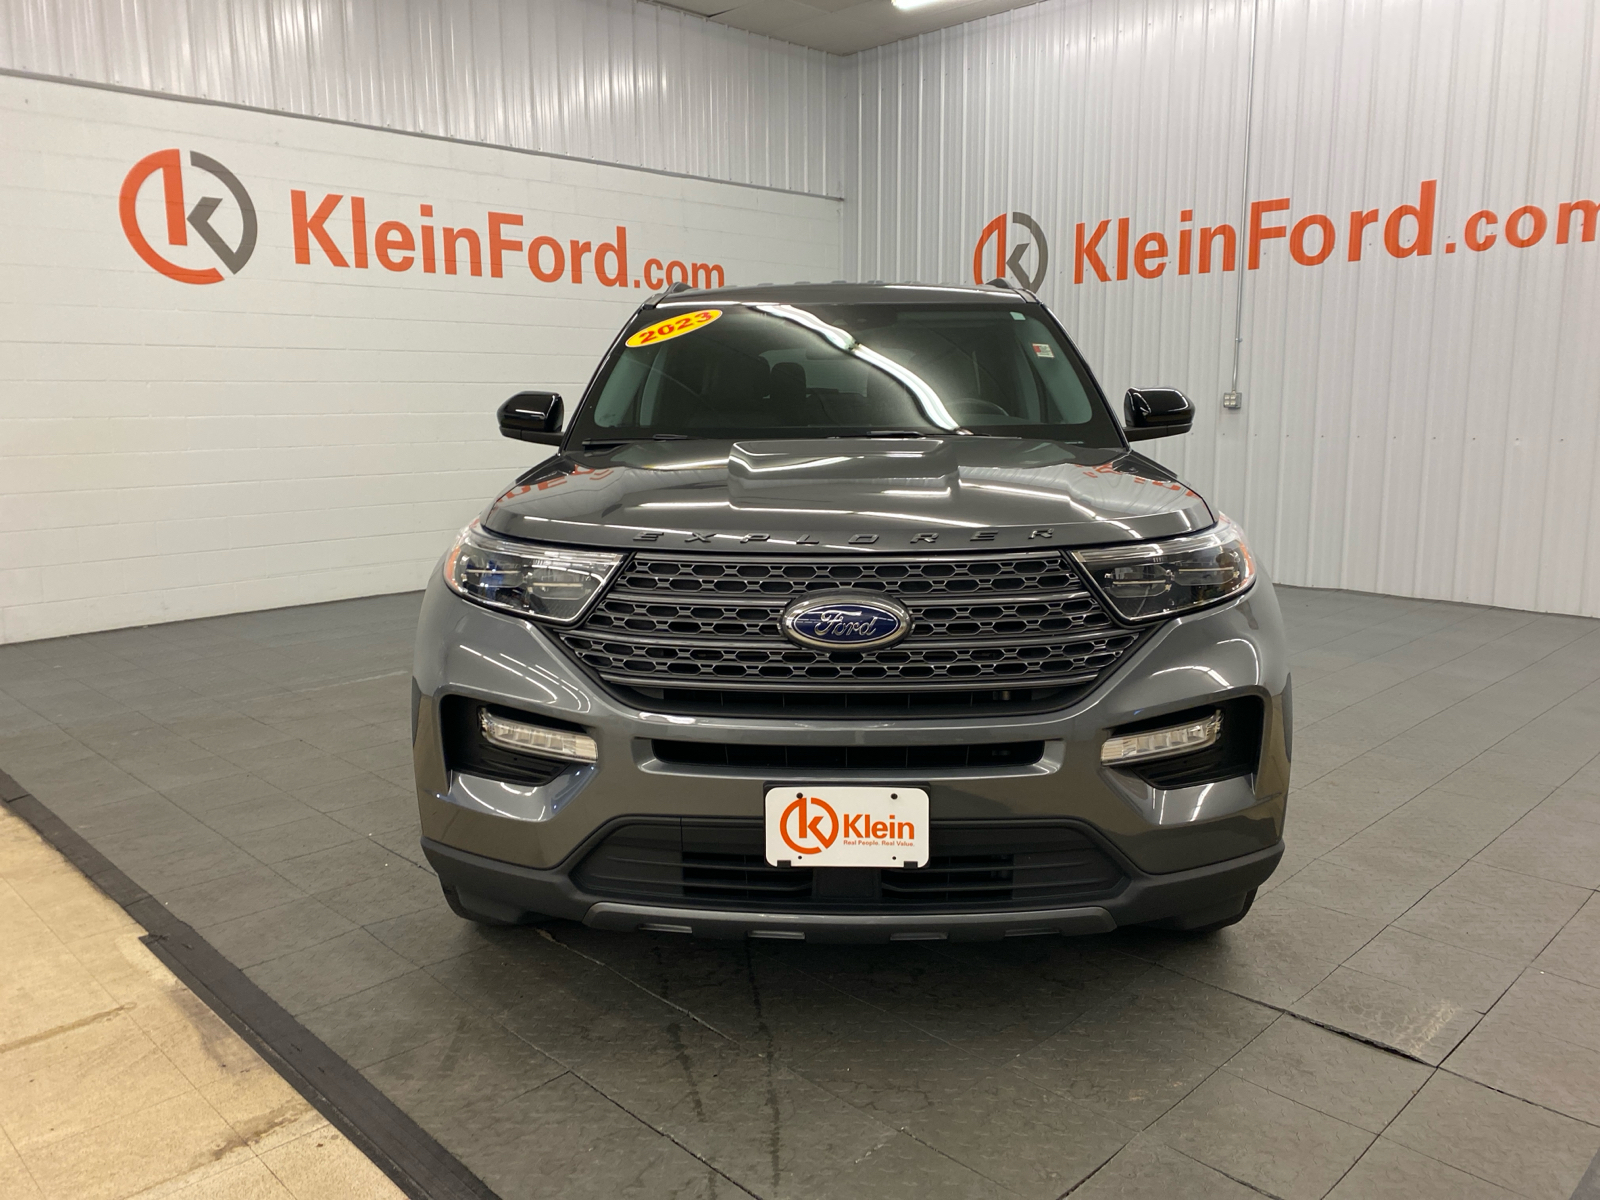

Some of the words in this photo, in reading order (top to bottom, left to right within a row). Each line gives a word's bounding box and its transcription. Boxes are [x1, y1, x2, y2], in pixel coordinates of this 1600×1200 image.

[290, 189, 725, 291] KleinFord.com
[639, 311, 713, 344] 2023
[632, 527, 1055, 545] EXPLORER
[813, 609, 878, 638] Ford
[843, 814, 915, 840] Klein
